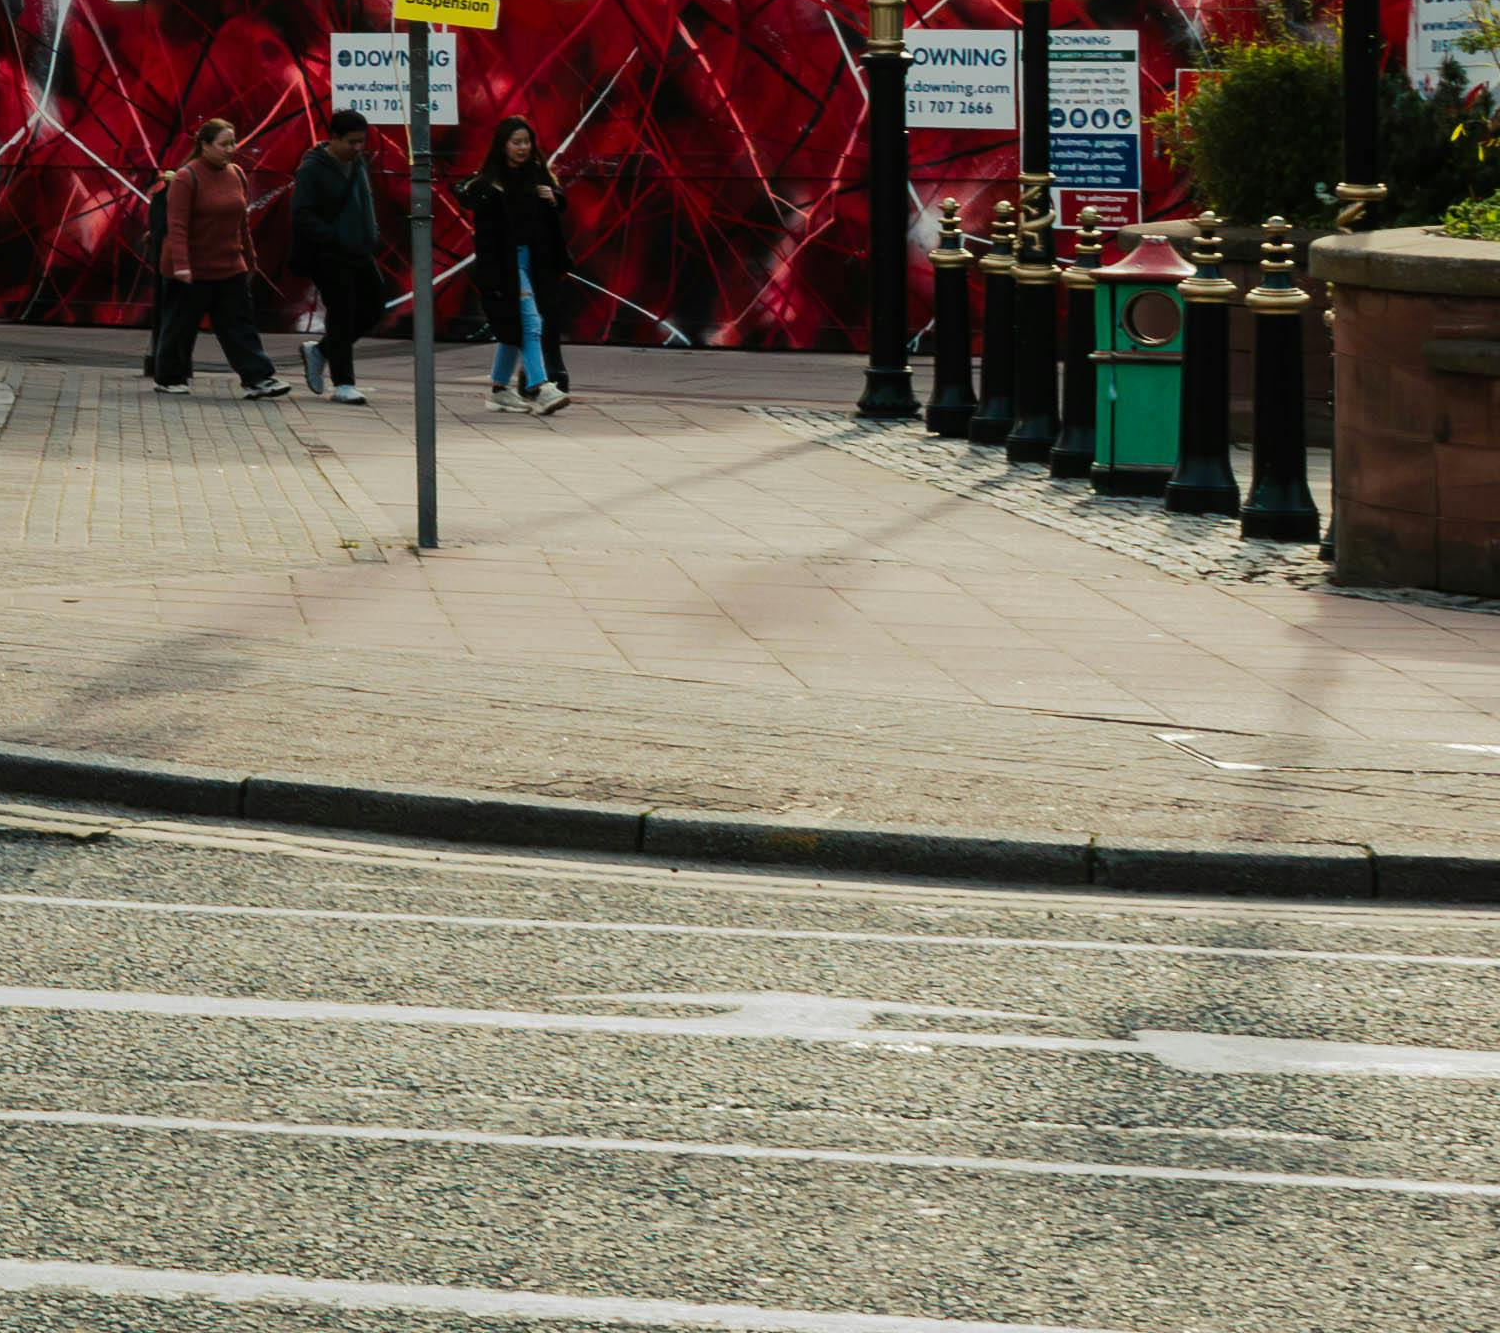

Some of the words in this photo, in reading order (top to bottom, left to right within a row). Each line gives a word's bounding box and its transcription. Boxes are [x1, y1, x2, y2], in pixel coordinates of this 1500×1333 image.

[908, 47, 1008, 67] OWNING
[907, 100, 922, 113] 51
[930, 100, 954, 113] 707
[959, 101, 994, 114] 2666
